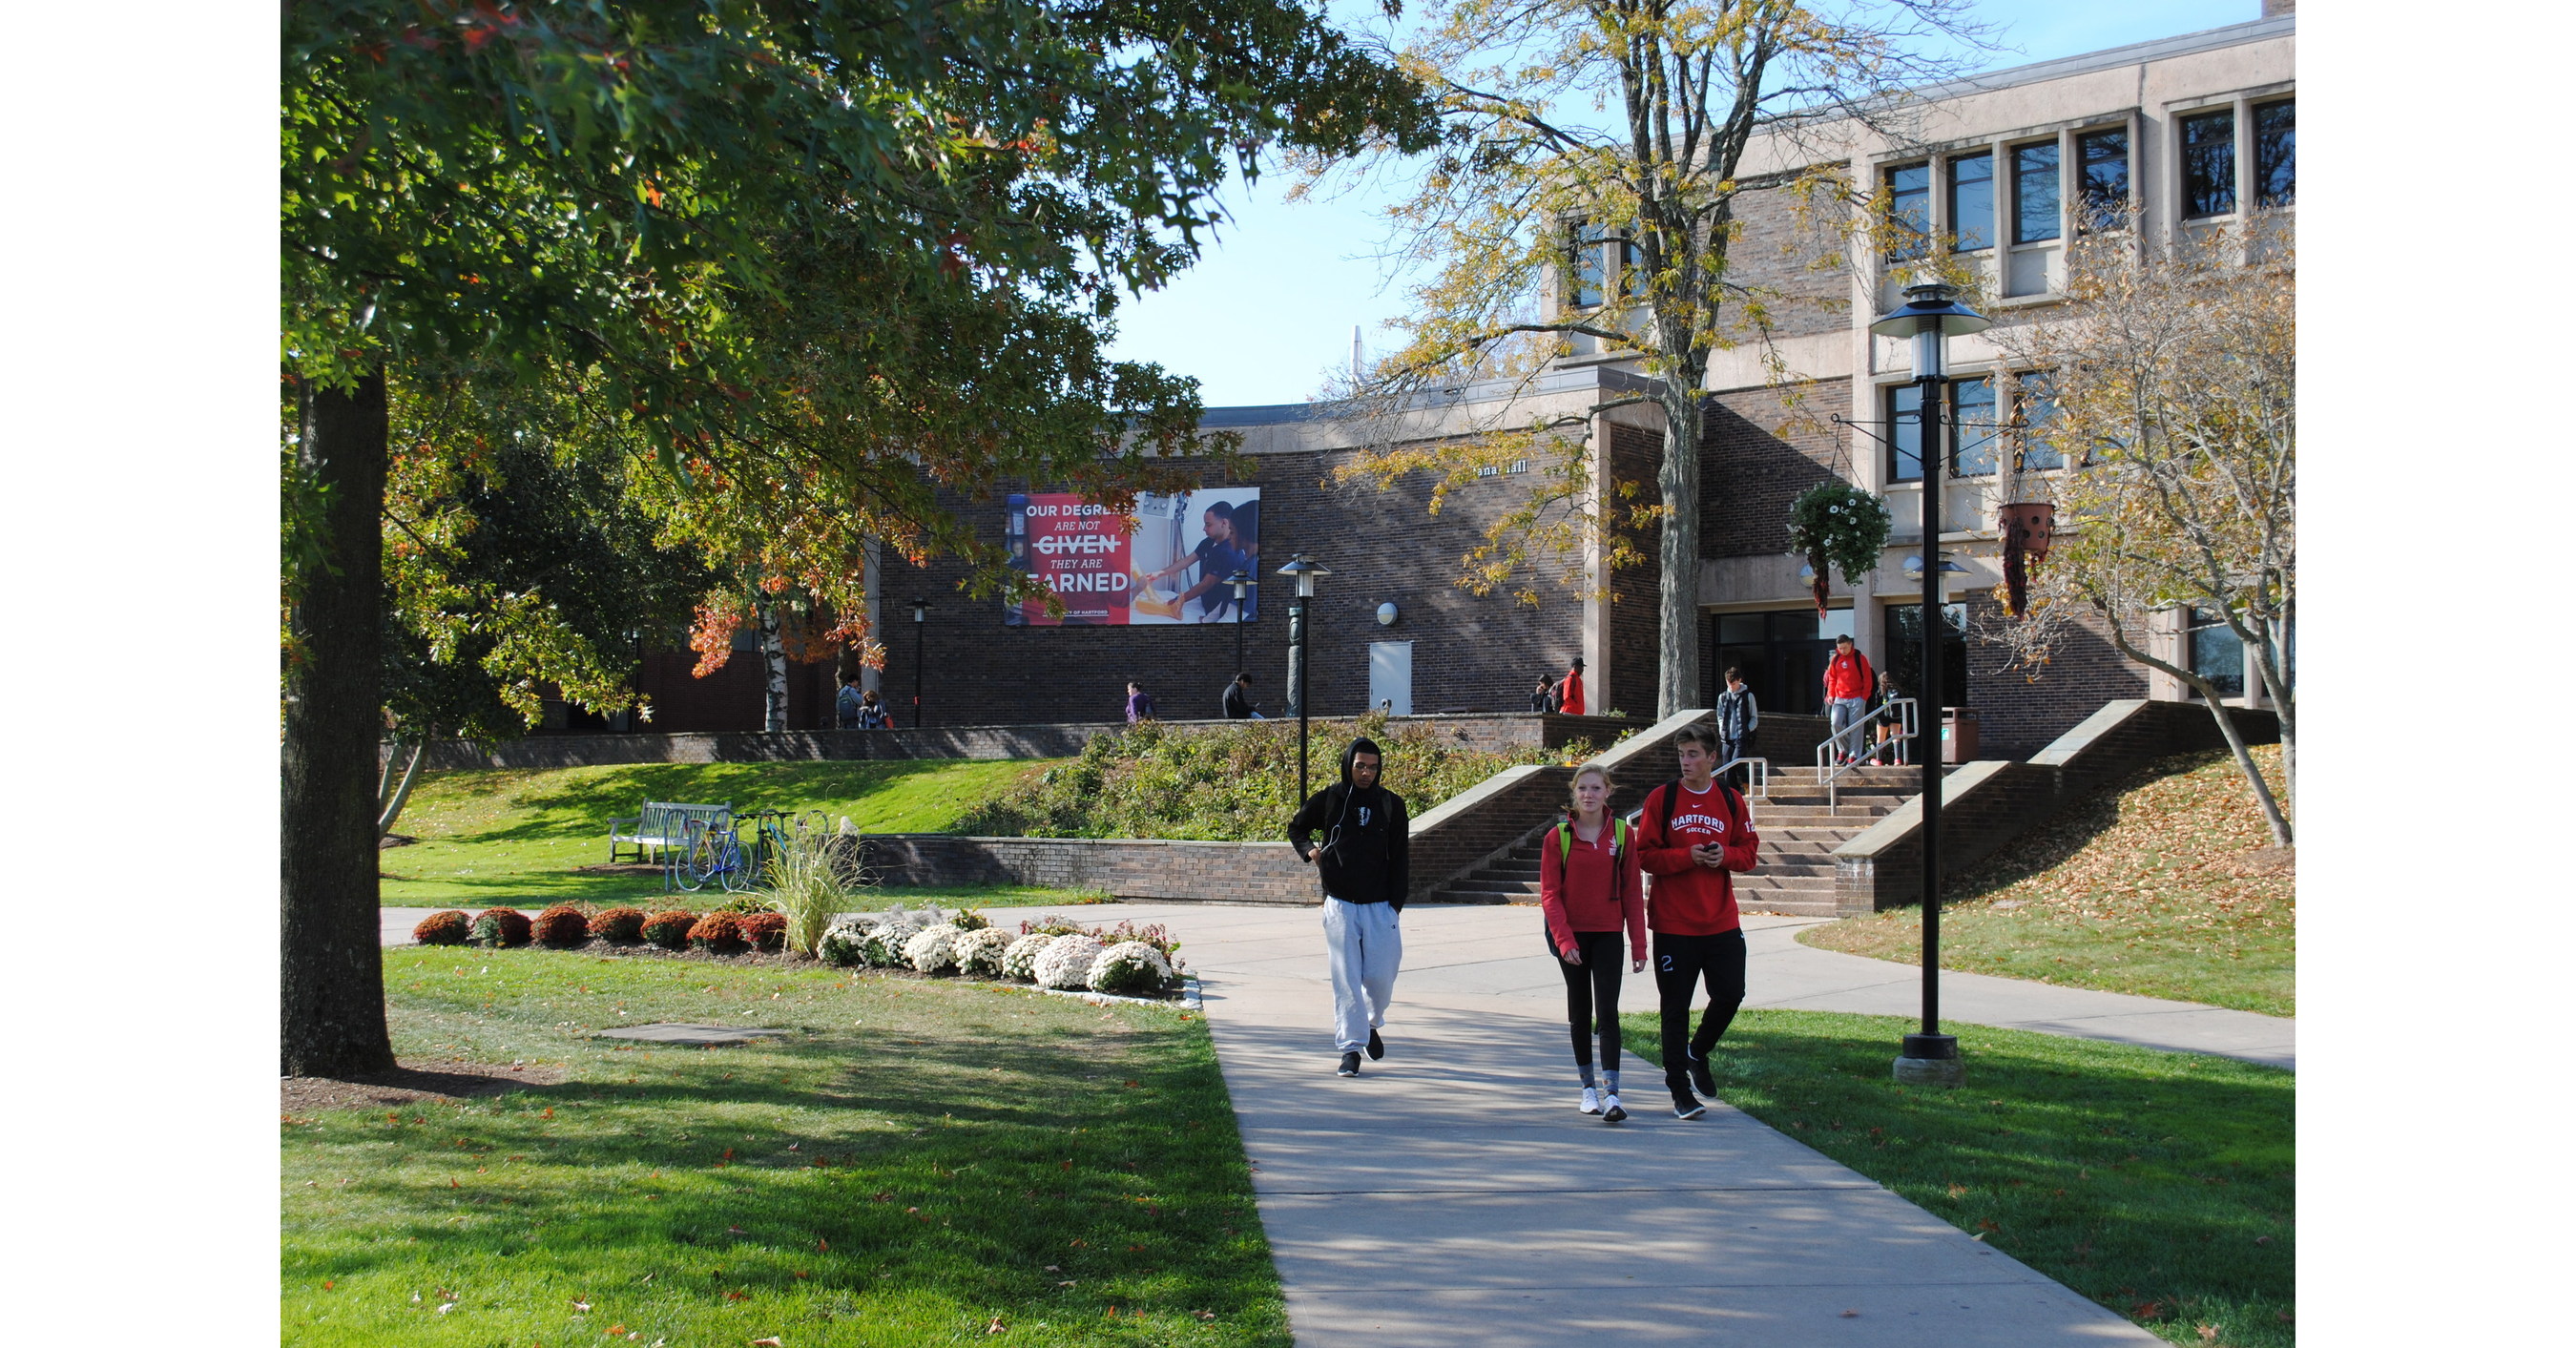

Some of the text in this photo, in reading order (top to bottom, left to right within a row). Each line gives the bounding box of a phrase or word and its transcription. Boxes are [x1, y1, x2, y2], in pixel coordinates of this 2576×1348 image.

[1470, 464, 1498, 476] ana
[1026, 504, 1130, 517] OUR DEGRE
[1054, 521, 1101, 531] ARE NOT
[1037, 534, 1116, 555] GIVEN
[1050, 558, 1103, 570] THEY ARE
[1671, 814, 1725, 832] HARTFORD
[1686, 826, 1712, 836] SOCCER
[1661, 954, 1674, 972] 2
